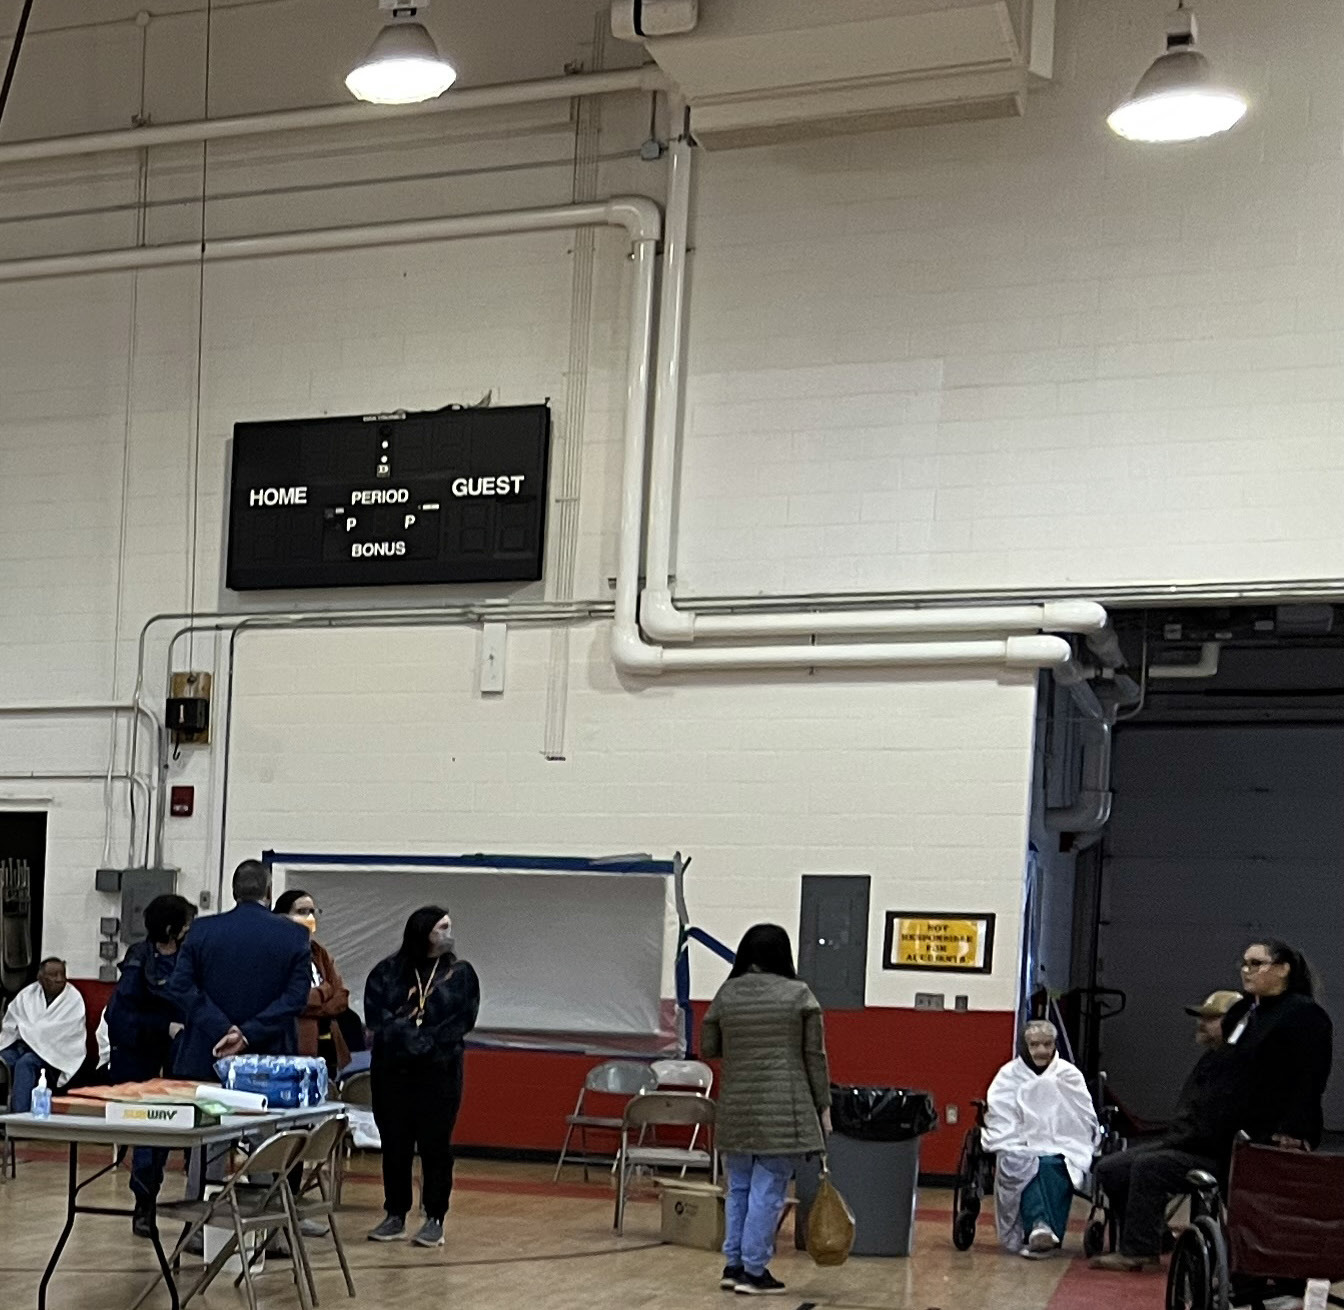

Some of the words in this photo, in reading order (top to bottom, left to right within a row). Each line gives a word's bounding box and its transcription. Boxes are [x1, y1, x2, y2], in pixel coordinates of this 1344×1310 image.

[451, 475, 525, 497] GUEST
[249, 486, 308, 507] HOME
[351, 488, 409, 506] PERIOD
[346, 516, 357, 532] P
[404, 514, 416, 530] P
[351, 540, 406, 558] BONUS
